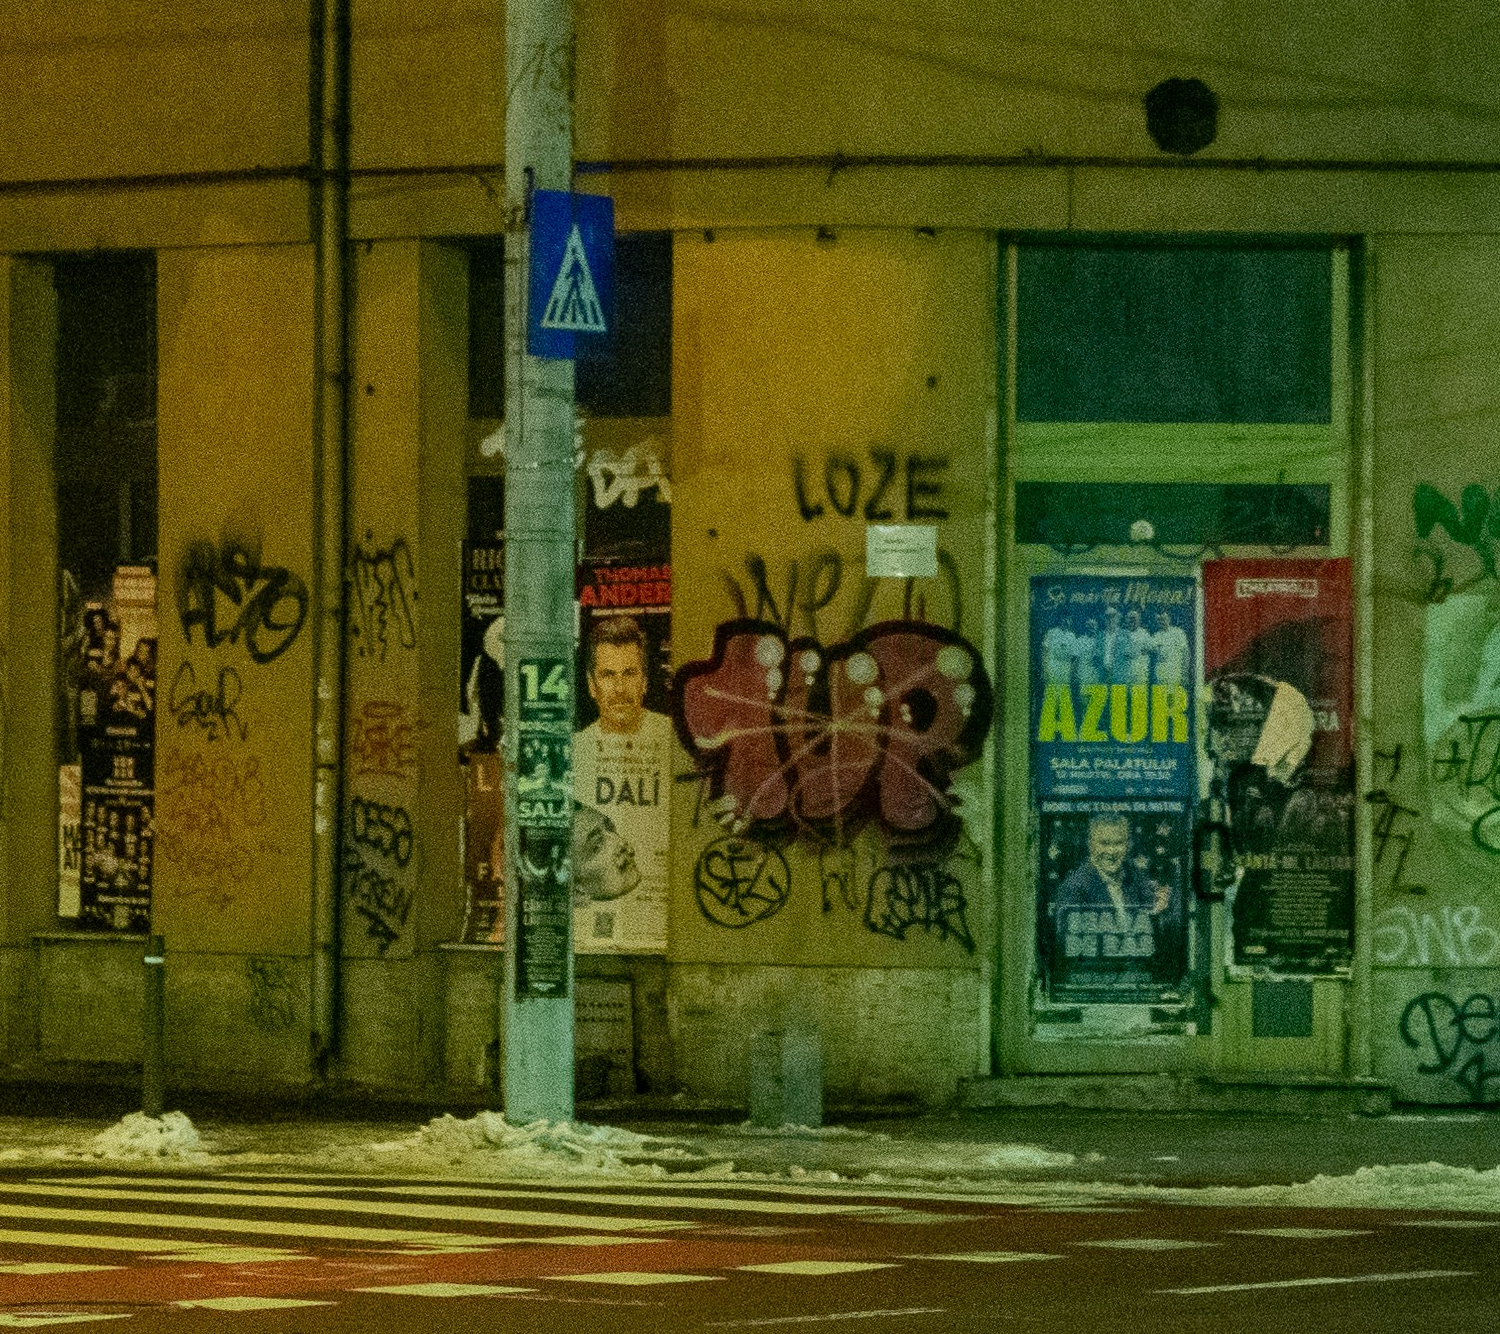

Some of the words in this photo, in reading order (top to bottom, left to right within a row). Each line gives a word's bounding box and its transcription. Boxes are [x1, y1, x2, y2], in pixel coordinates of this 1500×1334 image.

[789, 443, 950, 520] LOZE
[580, 581, 671, 607] ANDER
[521, 664, 569, 700] 14
[1037, 683, 1189, 743] AZUR
[1051, 757, 1090, 770] SALA
[596, 771, 660, 806] DALÍ
[518, 800, 570, 818] SALA
